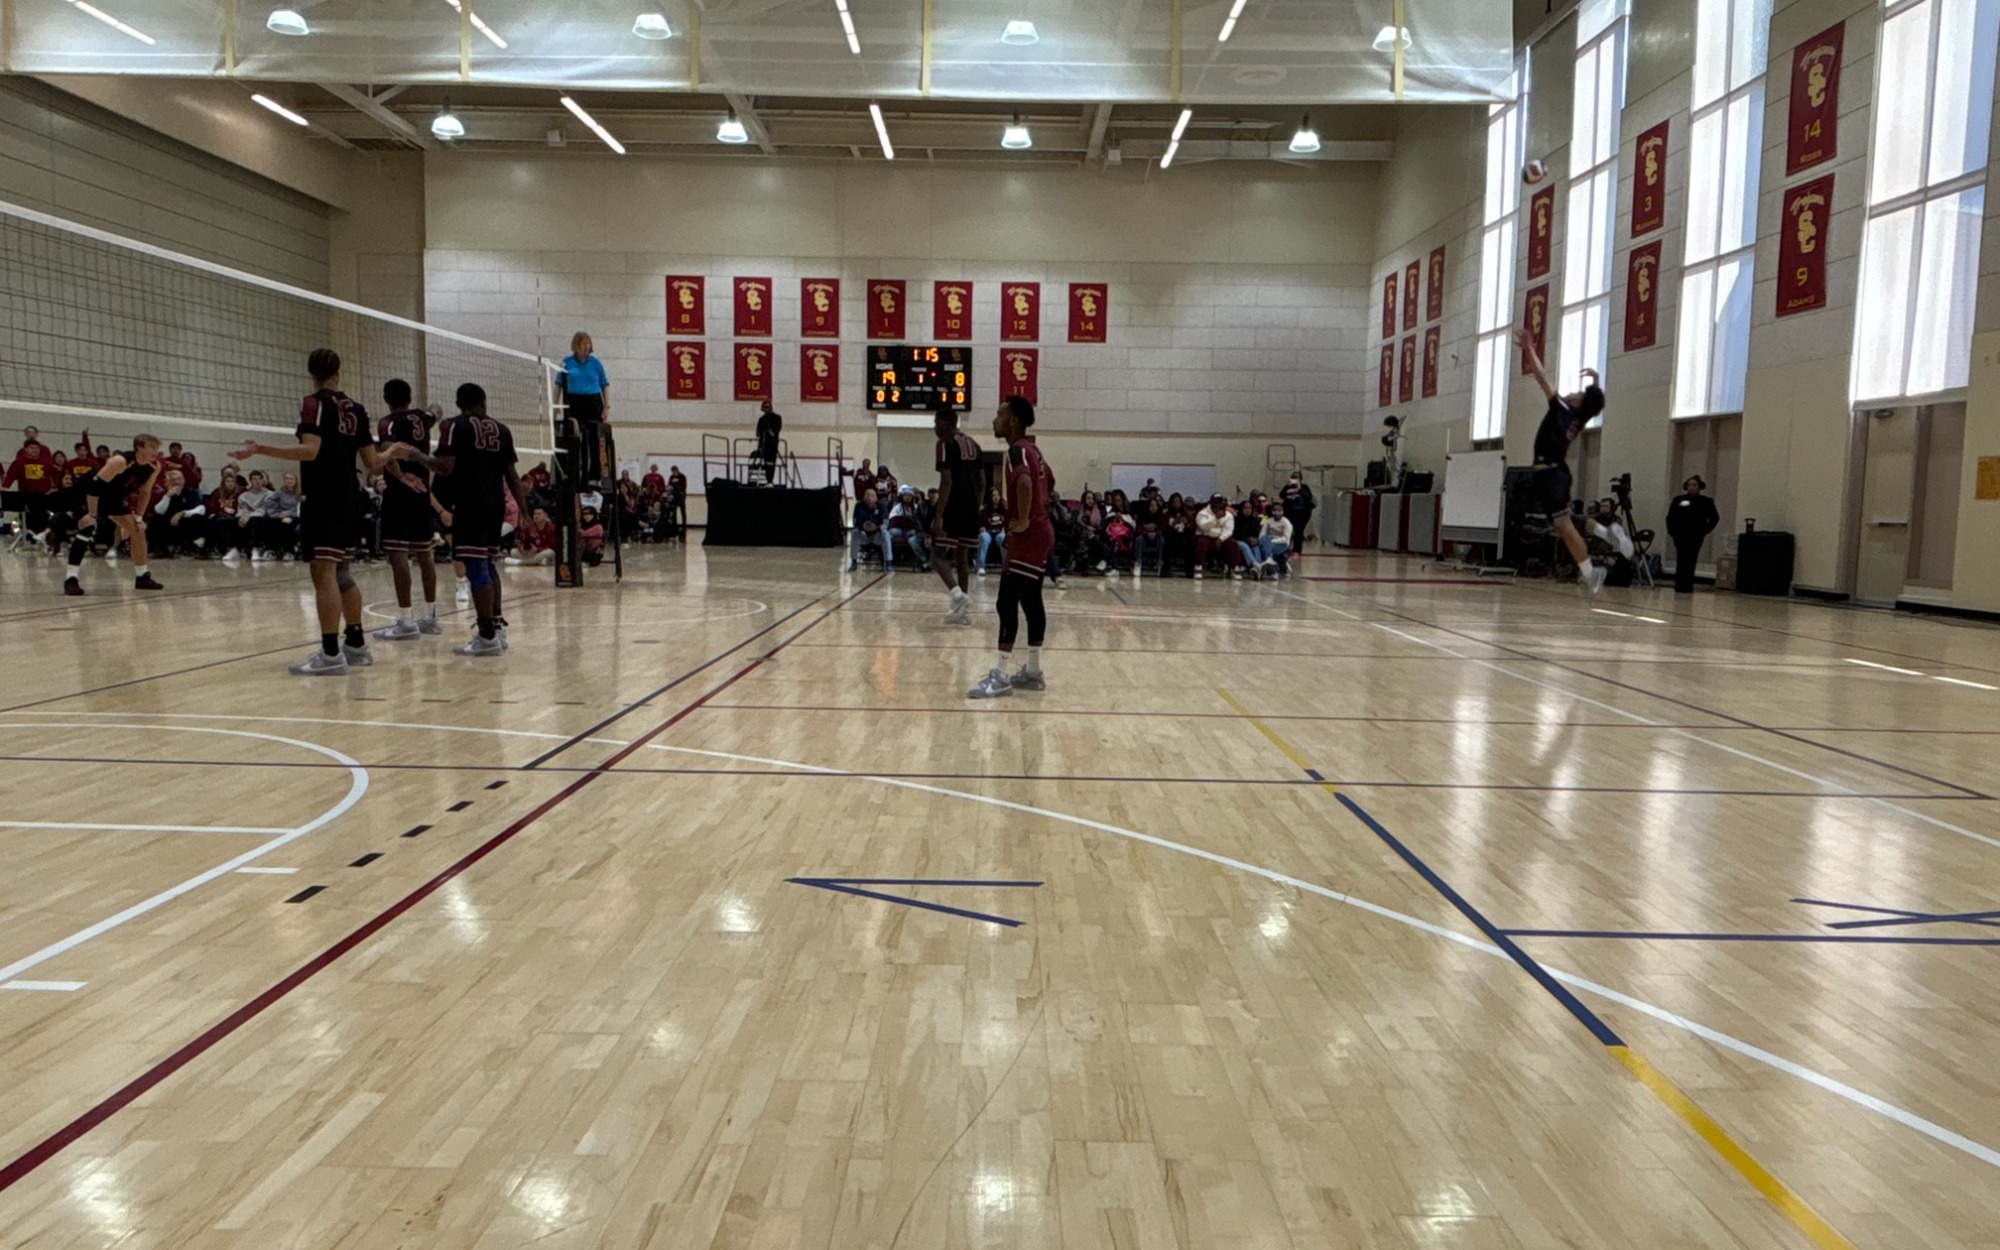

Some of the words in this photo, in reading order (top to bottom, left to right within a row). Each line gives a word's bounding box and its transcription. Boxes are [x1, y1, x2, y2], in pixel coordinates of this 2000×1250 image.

[1807, 63, 1827, 108] SC
[1804, 119, 1822, 143] 14
[1644, 150, 1658, 187] SC
[1643, 197, 1652, 212] 3
[1796, 211, 1816, 254] SC
[1796, 267, 1808, 287] 9
[1637, 268, 1651, 303] SC
[679, 289, 695, 310] SC
[746, 290, 762, 311] SC
[813, 291, 829, 312] SC
[880, 292, 896, 313] SC
[947, 294, 962, 315] SC
[1014, 295, 1029, 316] SC
[1081, 296, 1097, 317] SC
[681, 313, 691, 324] 8
[750, 316, 755, 325] 1
[815, 316, 825, 326] 9
[883, 318, 889, 328] 1
[946, 319, 960, 329] 10
[1013, 320, 1027, 330] 12
[1079, 321, 1095, 331] 14
[1636, 311, 1645, 326] 4
[913, 347, 939, 363] 1:15
[680, 354, 696, 375] SC
[746, 356, 762, 376] SC
[813, 357, 829, 377] SC
[1012, 360, 1028, 382] SC
[679, 379, 694, 389] 15
[746, 380, 760, 390] 10
[882, 370, 896, 385] 19
[918, 373, 924, 384] 1
[955, 372, 965, 387] 8
[815, 381, 825, 391] 6
[1012, 385, 1025, 395] 11
[876, 390, 885, 402] 0
[891, 390, 900, 402] 2
[941, 392, 947, 403] 1
[956, 391, 965, 404] 0
[469, 416, 501, 452] 12
[953, 434, 978, 461] 10
